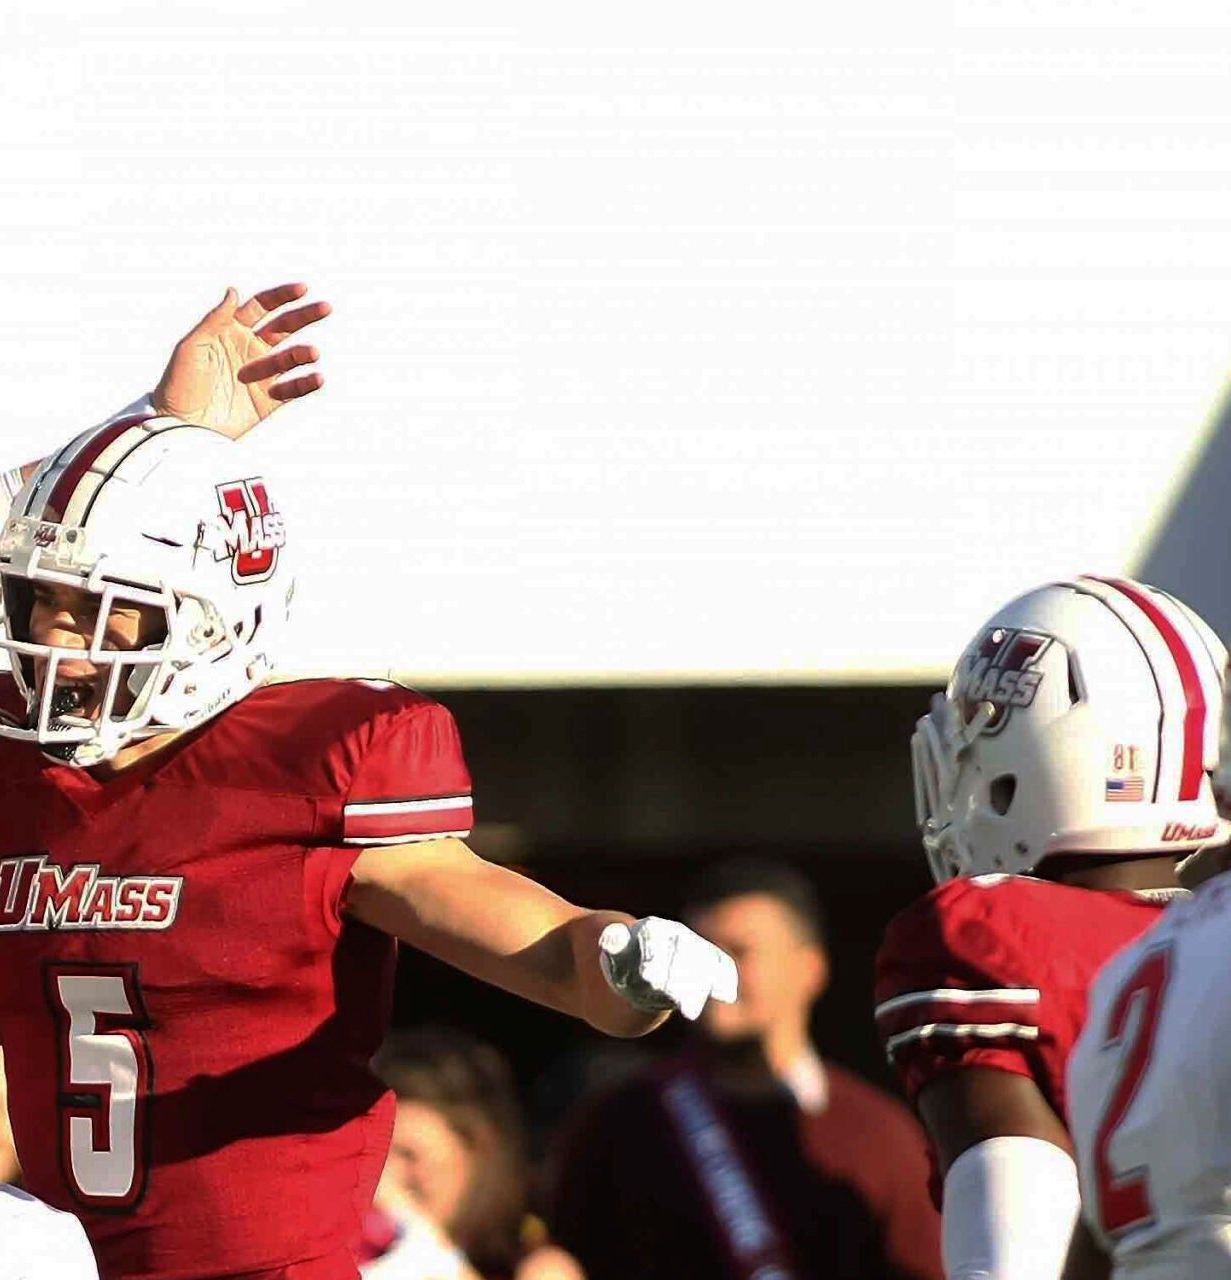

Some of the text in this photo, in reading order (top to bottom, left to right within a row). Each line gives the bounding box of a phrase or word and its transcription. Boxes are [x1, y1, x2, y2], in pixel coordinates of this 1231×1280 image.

[213, 510, 286, 562] MASS
[215, 477, 278, 585] U
[1112, 743, 1140, 771] 81
[50, 968, 147, 1207] 5
[1095, 938, 1175, 1231] 2
